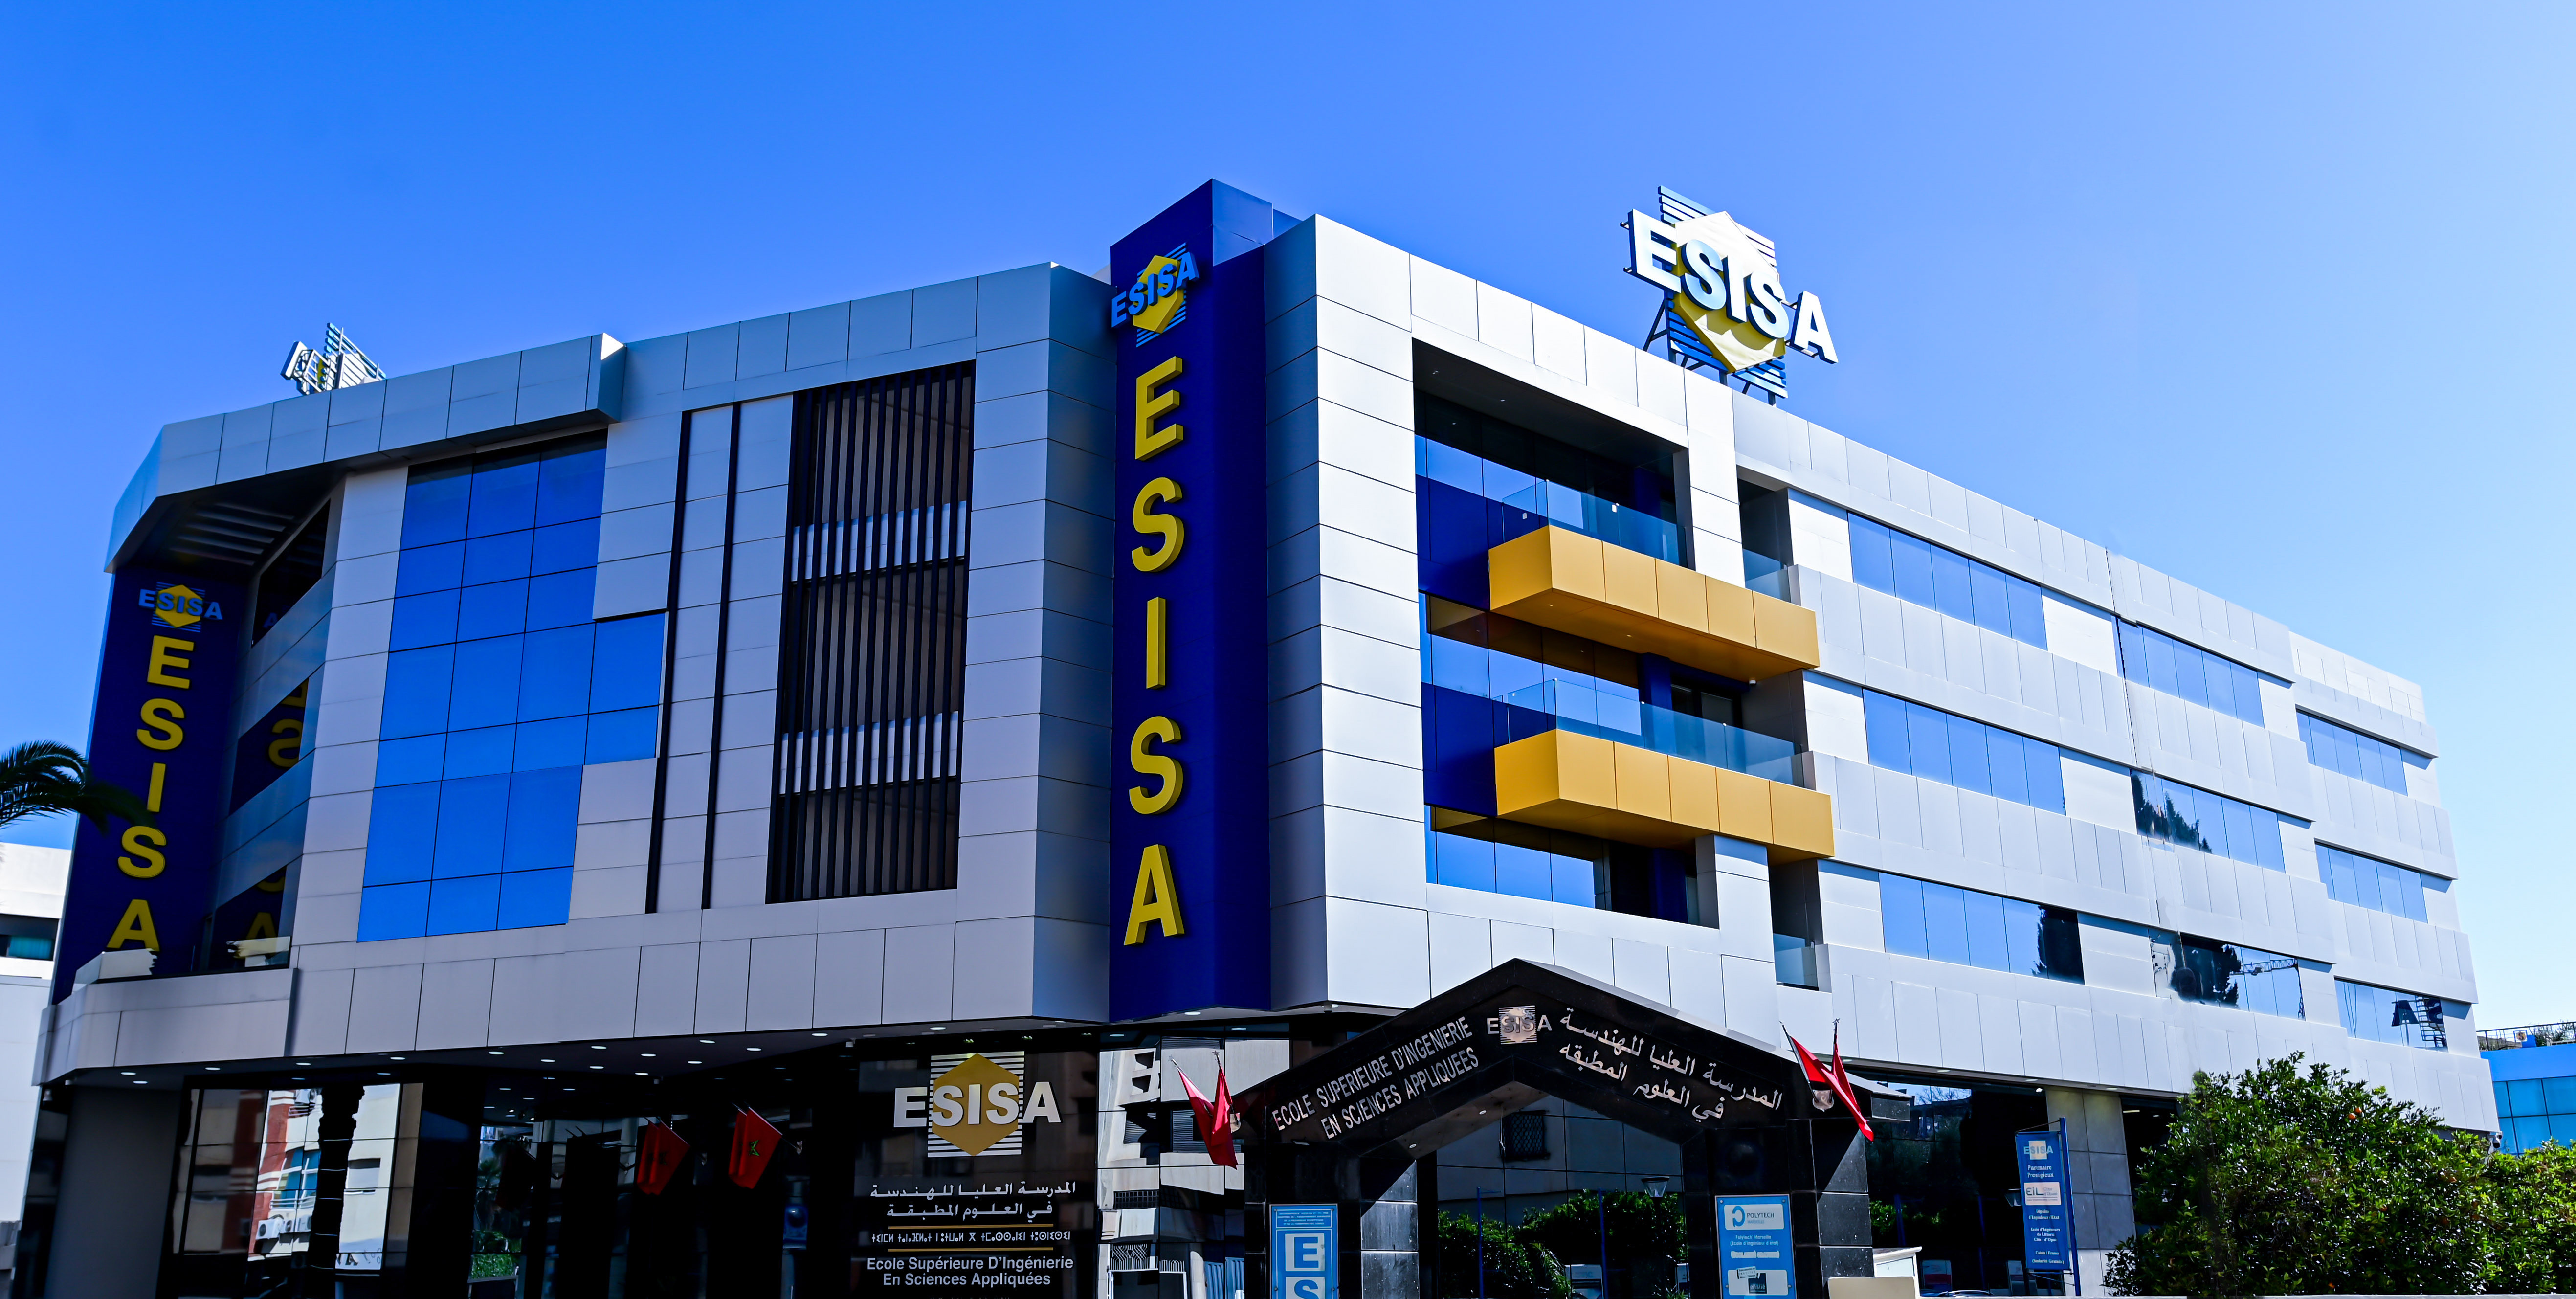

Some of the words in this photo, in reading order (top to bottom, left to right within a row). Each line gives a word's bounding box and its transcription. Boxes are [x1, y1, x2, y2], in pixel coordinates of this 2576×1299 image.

[1111, 251, 1199, 330] ESISA
[1628, 208, 1839, 364] ESISA
[139, 589, 222, 620] ESISA
[1124, 356, 1184, 945] ESISA
[106, 635, 195, 952] ESISA
[1487, 1015, 1553, 1034] ESISA
[1560, 1007, 1644, 1056] للهندسة
[1272, 1094, 1315, 1131] ECOLE
[1316, 1056, 1392, 1107] SUPERIEURE
[1391, 1016, 1472, 1070] D'INGENIERIE
[1650, 1044, 1695, 1076] العليا
[1321, 1114, 1342, 1139] EN
[1341, 1085, 1402, 1129] SCIENCES
[1404, 1047, 1478, 1099] APPLIQUEES
[1633, 1079, 1690, 1108] العلوم
[1703, 1062, 1782, 1110] المدرسة
[893, 1081, 1061, 1128] ESISA
[1692, 1096, 1725, 1122] في
[2023, 1145, 2053, 1154] ESISA
[870, 1184, 954, 1200] للهندسة
[958, 1183, 1012, 1199] العليا
[1018, 1181, 1075, 1197] المدرسة
[887, 1204, 958, 1220] المطبقة
[963, 1203, 1022, 1221] العلوم
[1027, 1201, 1052, 1223] في
[867, 1258, 905, 1270] Ecole
[909, 1256, 983, 1272] Supérieure
[988, 1256, 1073, 1272] D'Ingénierie
[884, 1273, 900, 1285] En
[905, 1273, 966, 1286] Sciences
[971, 1272, 1050, 1288] Appliquées
